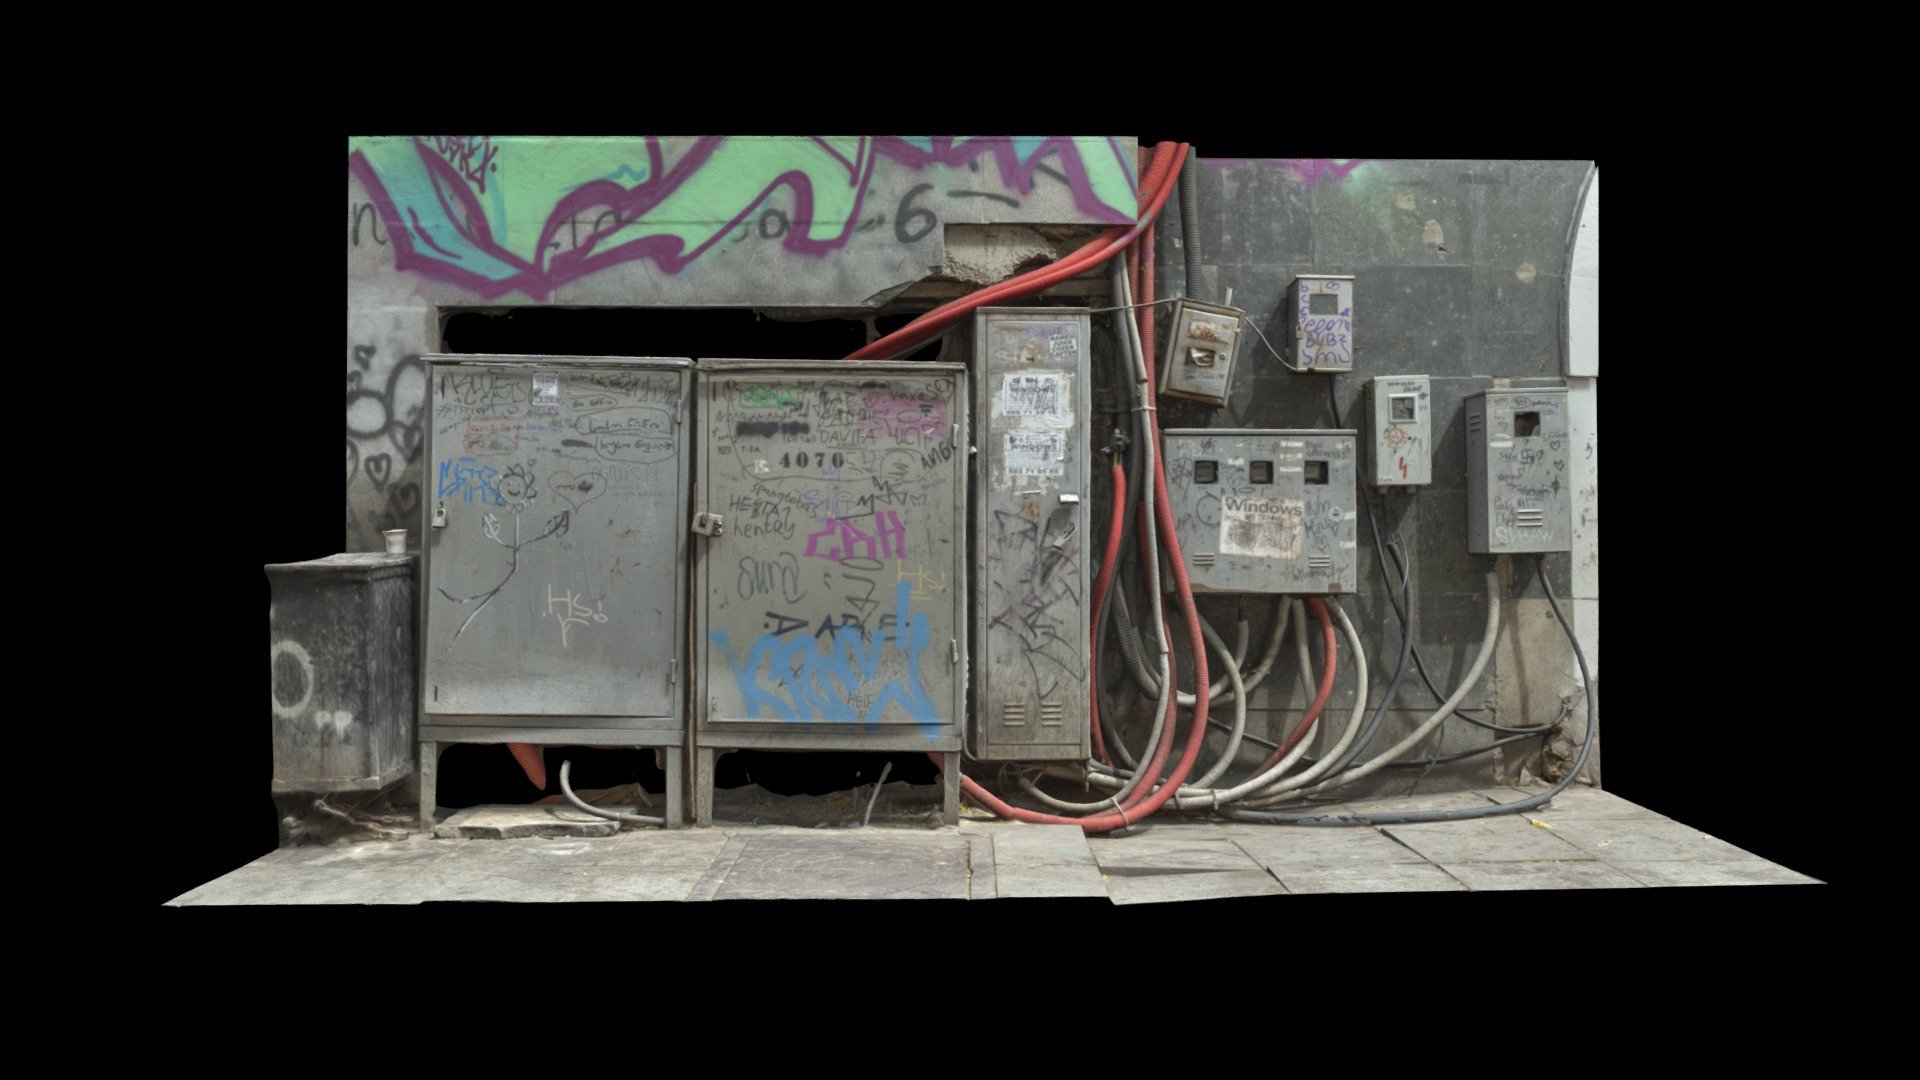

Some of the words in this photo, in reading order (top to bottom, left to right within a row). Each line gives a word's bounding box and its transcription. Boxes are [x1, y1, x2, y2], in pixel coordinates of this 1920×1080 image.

[1011, 443, 1057, 451] WINDOWS
[779, 452, 844, 469] 4070
[1225, 498, 1303, 516] Windows
